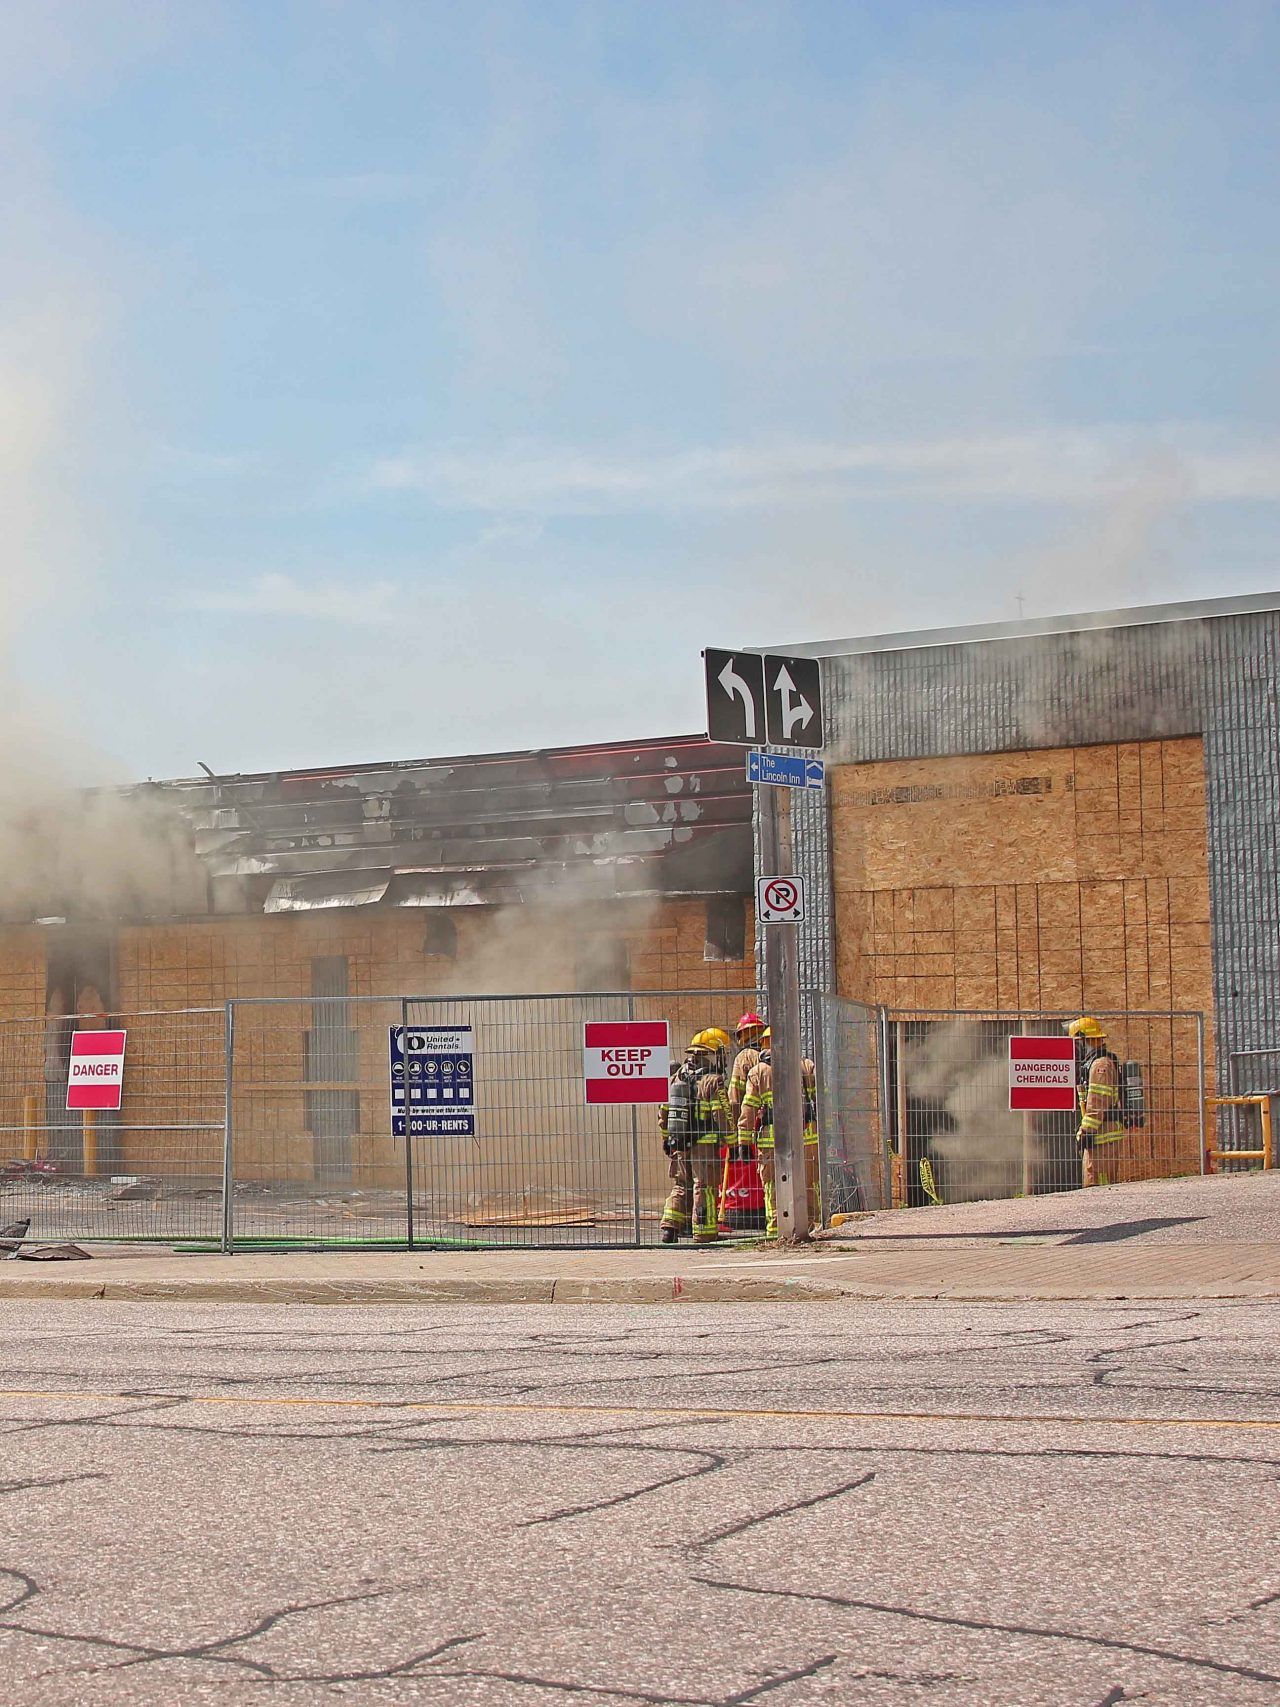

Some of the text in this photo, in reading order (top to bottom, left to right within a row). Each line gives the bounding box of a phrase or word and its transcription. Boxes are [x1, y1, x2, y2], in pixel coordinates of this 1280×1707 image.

[761, 756, 775, 768] The
[762, 769, 801, 785] Lincoln Inn
[601, 1049, 652, 1062] KEEP
[73, 1064, 119, 1076] DANGER
[607, 1063, 647, 1076] OUT
[1014, 1064, 1071, 1072] DANGEROUS
[1016, 1075, 1069, 1084] CHEMICALS
[397, 1119, 469, 1131] 1-00-UR-RENTS
